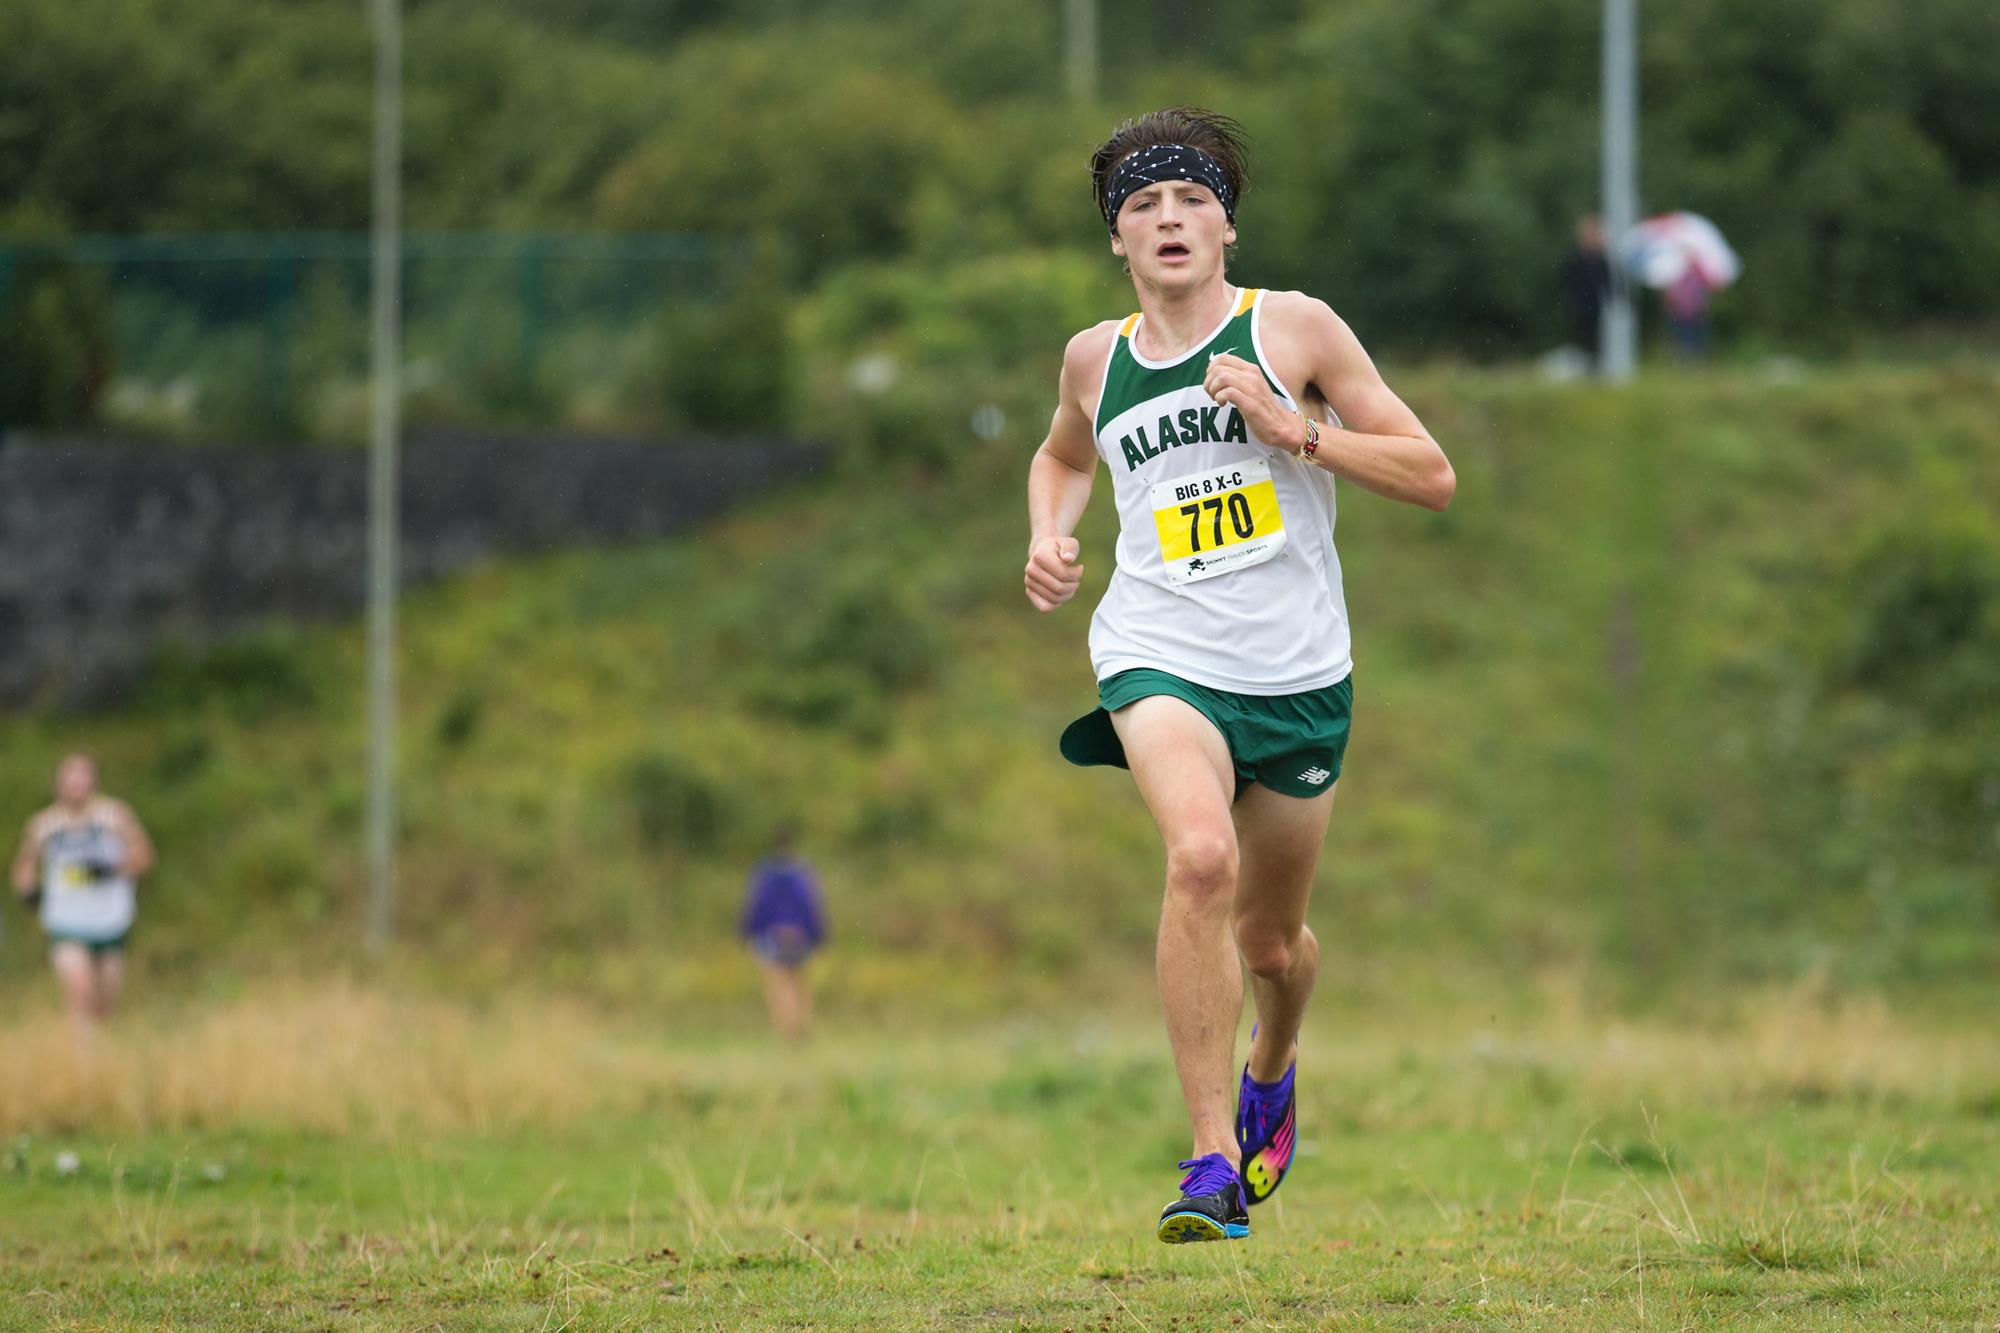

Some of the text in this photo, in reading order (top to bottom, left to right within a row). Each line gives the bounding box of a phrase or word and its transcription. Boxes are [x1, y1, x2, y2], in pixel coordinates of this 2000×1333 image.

[1120, 406, 1248, 472] ALASKA
[1175, 471, 1243, 501] BIG 8 X-C
[1180, 492, 1254, 552] 770
[1246, 544, 1268, 555] SPORTS
